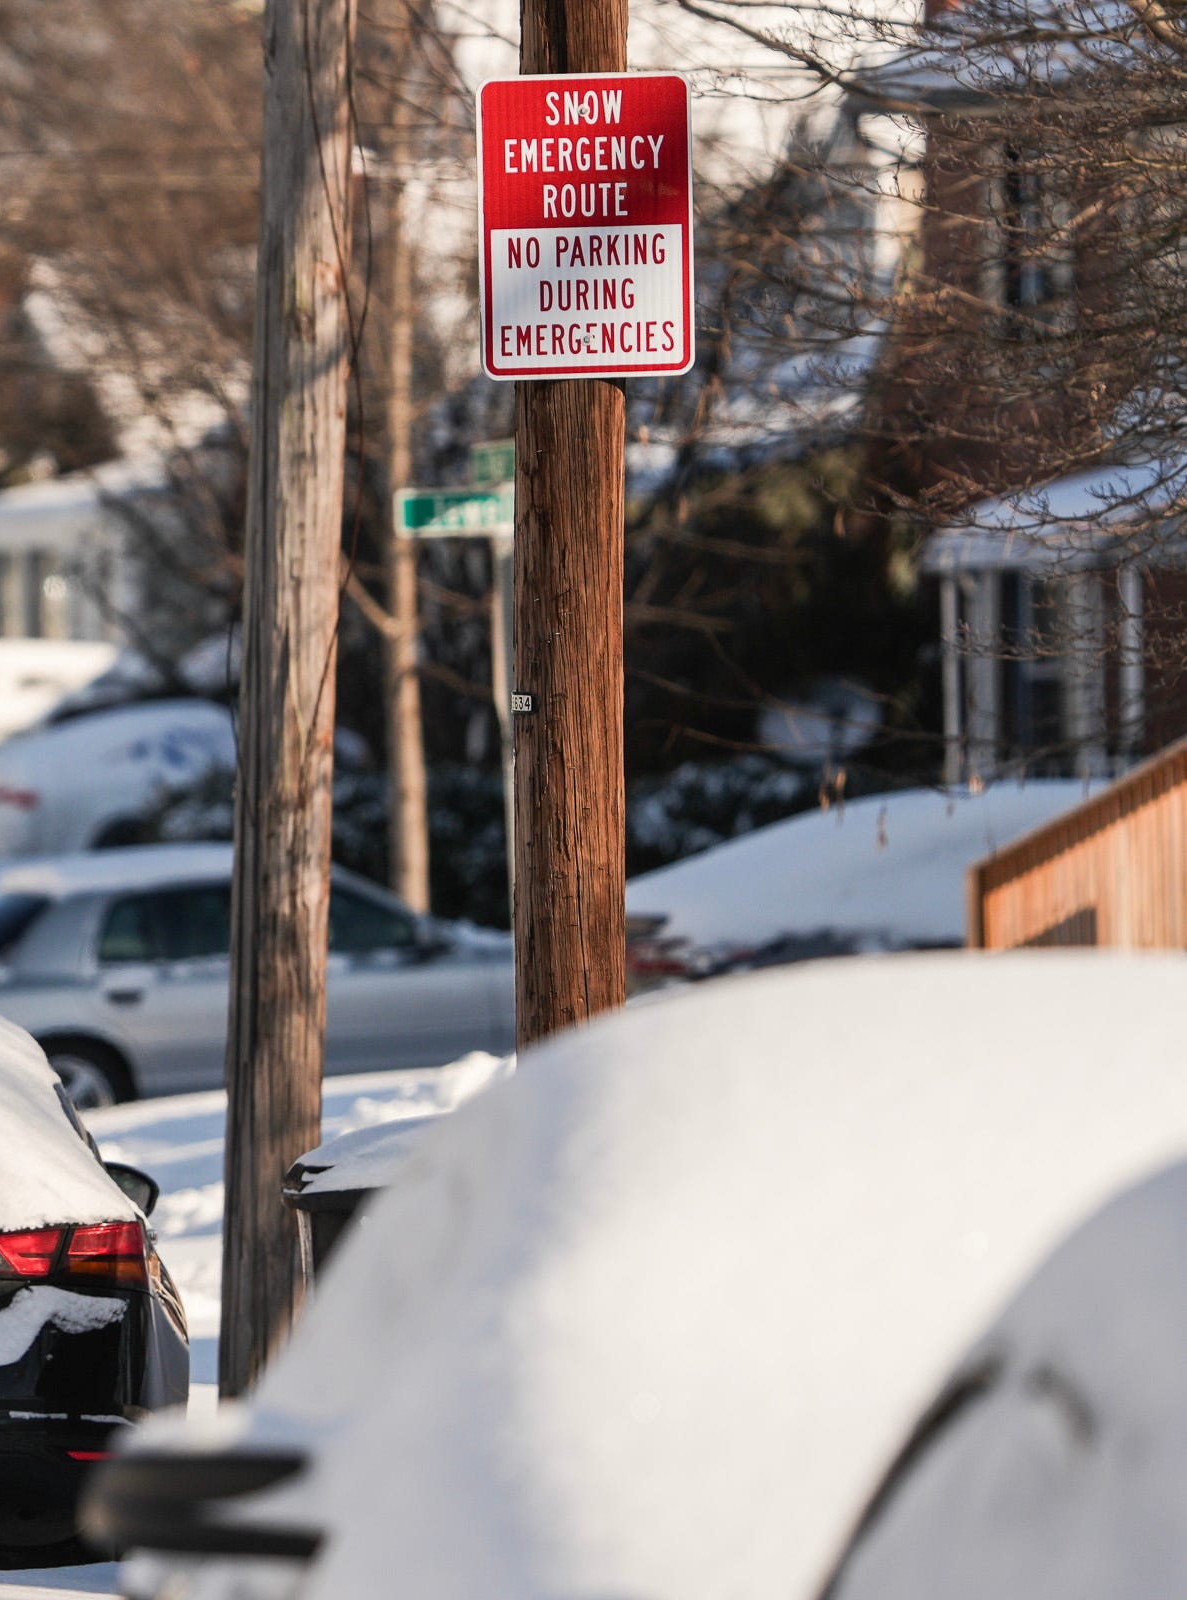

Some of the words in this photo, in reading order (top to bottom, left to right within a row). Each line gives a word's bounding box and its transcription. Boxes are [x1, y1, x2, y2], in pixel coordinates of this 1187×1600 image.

[545, 90, 623, 126] SNOW
[504, 135, 664, 174] EMERGENCY
[543, 182, 628, 218] ROUTE
[508, 236, 540, 269] NO
[555, 232, 666, 267] PARKING
[539, 278, 635, 312] DURING
[500, 320, 675, 357] EMERGENCIES
